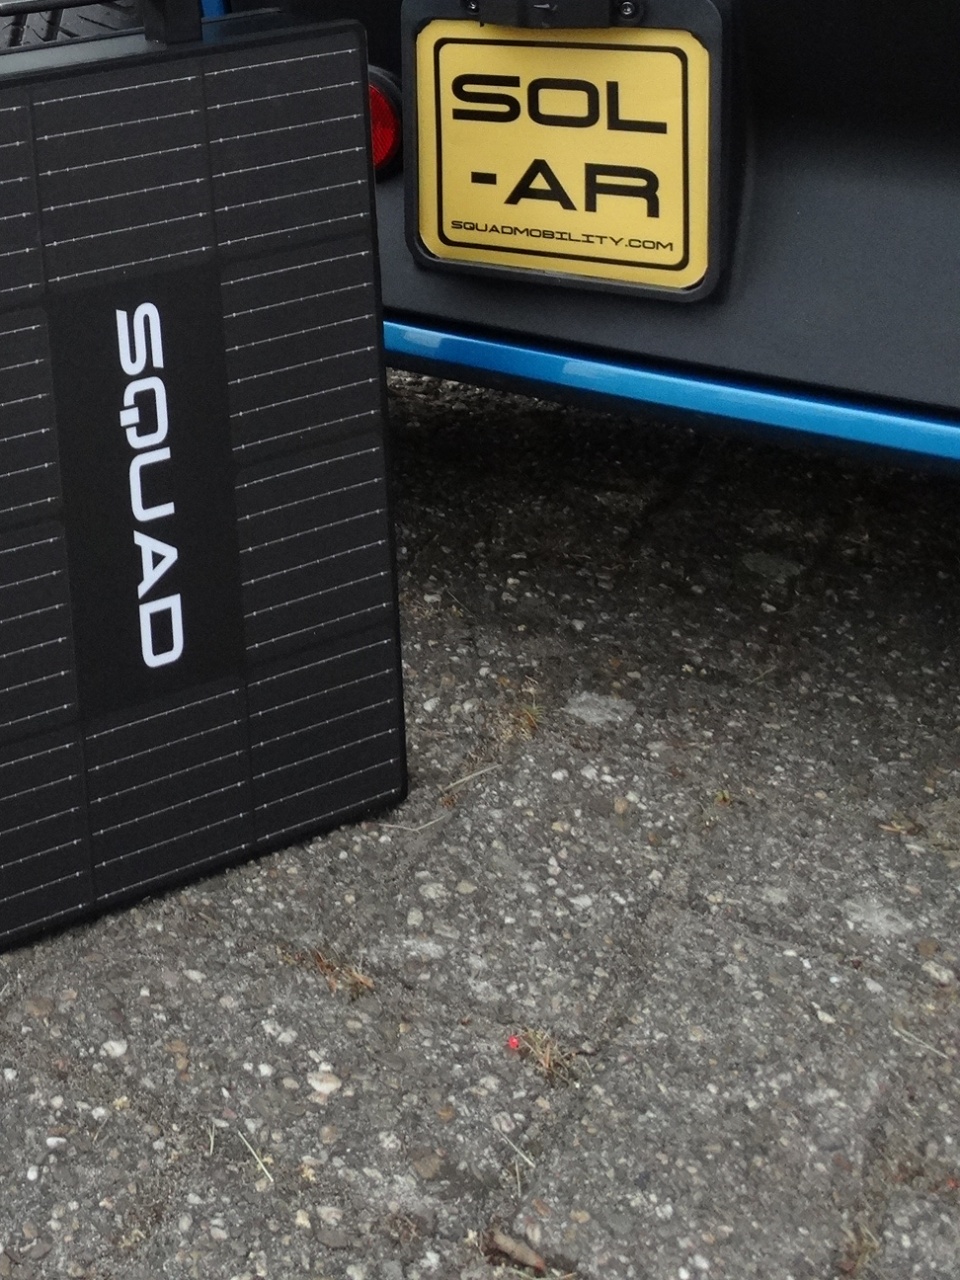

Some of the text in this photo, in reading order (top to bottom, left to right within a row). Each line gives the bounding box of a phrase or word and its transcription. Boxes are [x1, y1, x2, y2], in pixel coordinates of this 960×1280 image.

[451, 73, 668, 134] SOL
[470, 158, 660, 219] -AR
[450, 220, 674, 252] SQUADMOBILITY.COM
[116, 302, 185, 669] SQUAD
